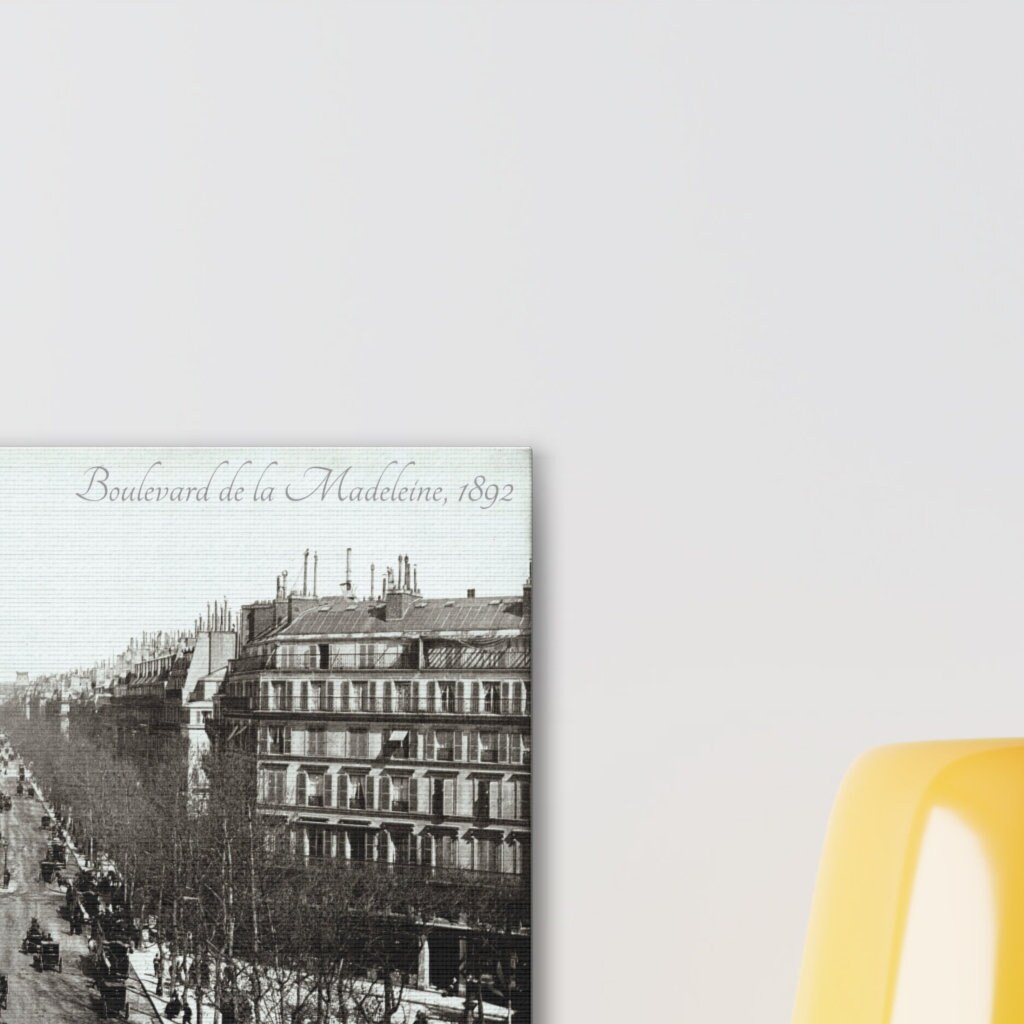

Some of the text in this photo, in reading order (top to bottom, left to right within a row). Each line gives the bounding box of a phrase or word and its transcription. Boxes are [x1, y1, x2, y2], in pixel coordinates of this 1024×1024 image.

[75, 460, 514, 509] Boulevard de la Madeleine, 1892
